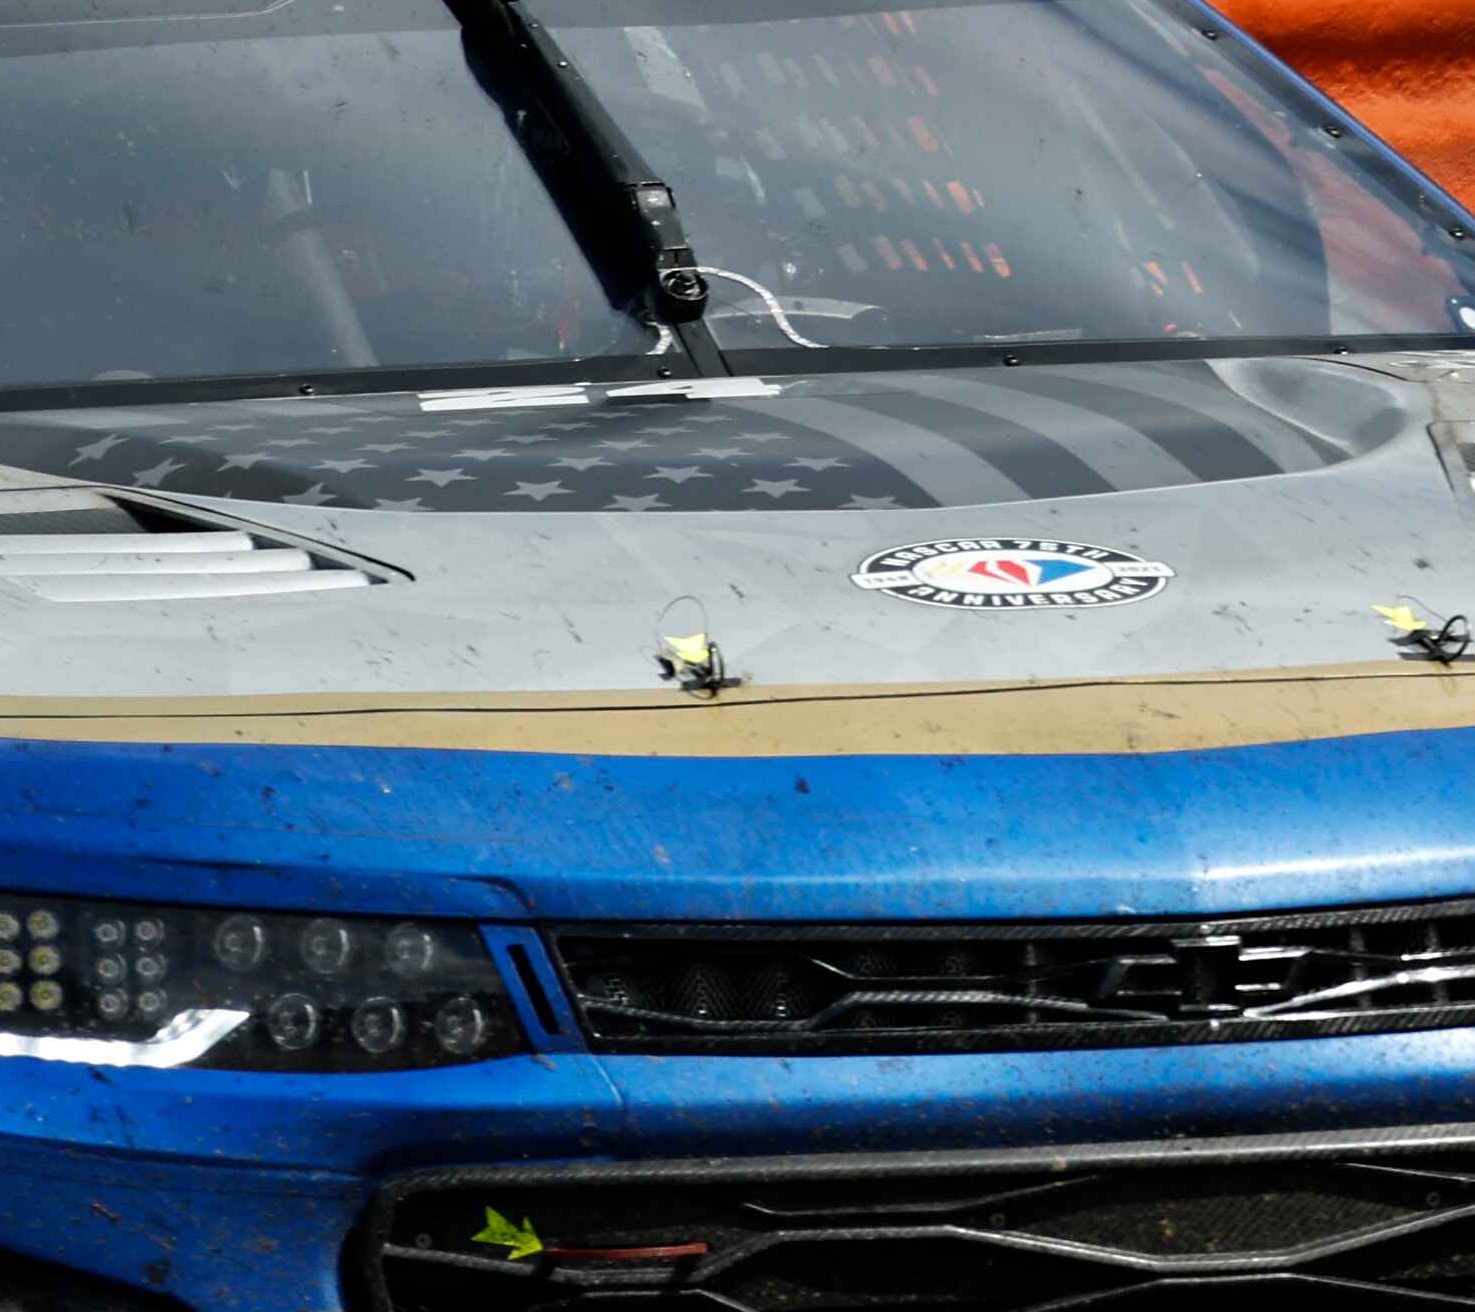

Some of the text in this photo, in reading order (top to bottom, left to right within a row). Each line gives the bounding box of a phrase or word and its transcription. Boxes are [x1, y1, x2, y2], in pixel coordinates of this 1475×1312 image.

[880, 540, 1109, 567] NASCAR 75TH
[906, 576, 1149, 607] ANNIVERSARY
